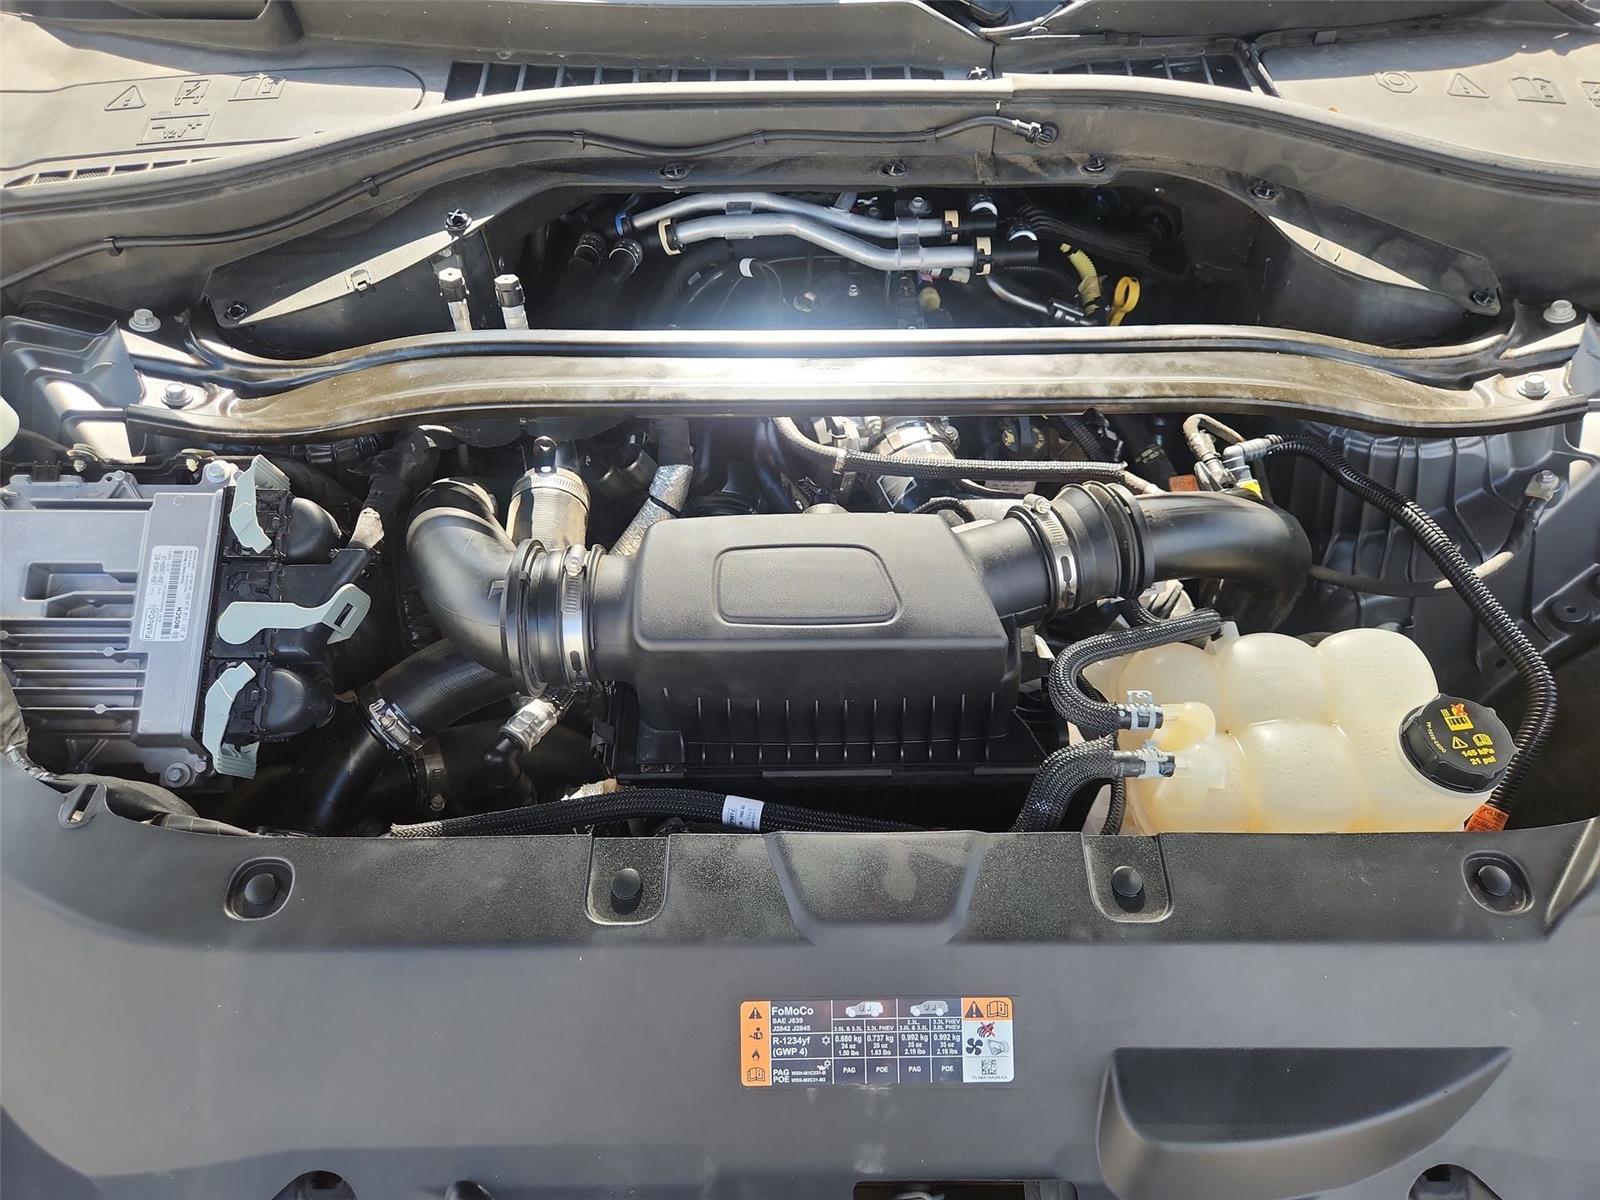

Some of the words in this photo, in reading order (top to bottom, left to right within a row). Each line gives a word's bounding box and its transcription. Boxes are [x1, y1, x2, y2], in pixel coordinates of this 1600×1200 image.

[163, 128, 187, 139] 12V
[174, 606, 182, 629] BOSCH
[145, 609, 156, 639] FoMoCo
[1461, 749, 1478, 757] 145
[1477, 747, 1495, 755] kPa
[1470, 757, 1482, 765] 21
[1482, 756, 1496, 765] psi
[771, 1006, 814, 1016] FoMoCo
[772, 1036, 811, 1047] R-1234yf
[834, 1035, 853, 1043] 0.680
[853, 1034, 863, 1044] kg
[866, 1034, 885, 1042] 0.737
[885, 1034, 894, 1044] kg
[901, 1033, 919, 1041] 0.992
[919, 1033, 929, 1043] kg
[933, 1033, 951, 1041] 0.992
[951, 1033, 961, 1043] kg
[772, 1047, 798, 1058] (GWP
[799, 1047, 808, 1057] 4)
[772, 1068, 790, 1076] PAG
[772, 1075, 791, 1083] POE
